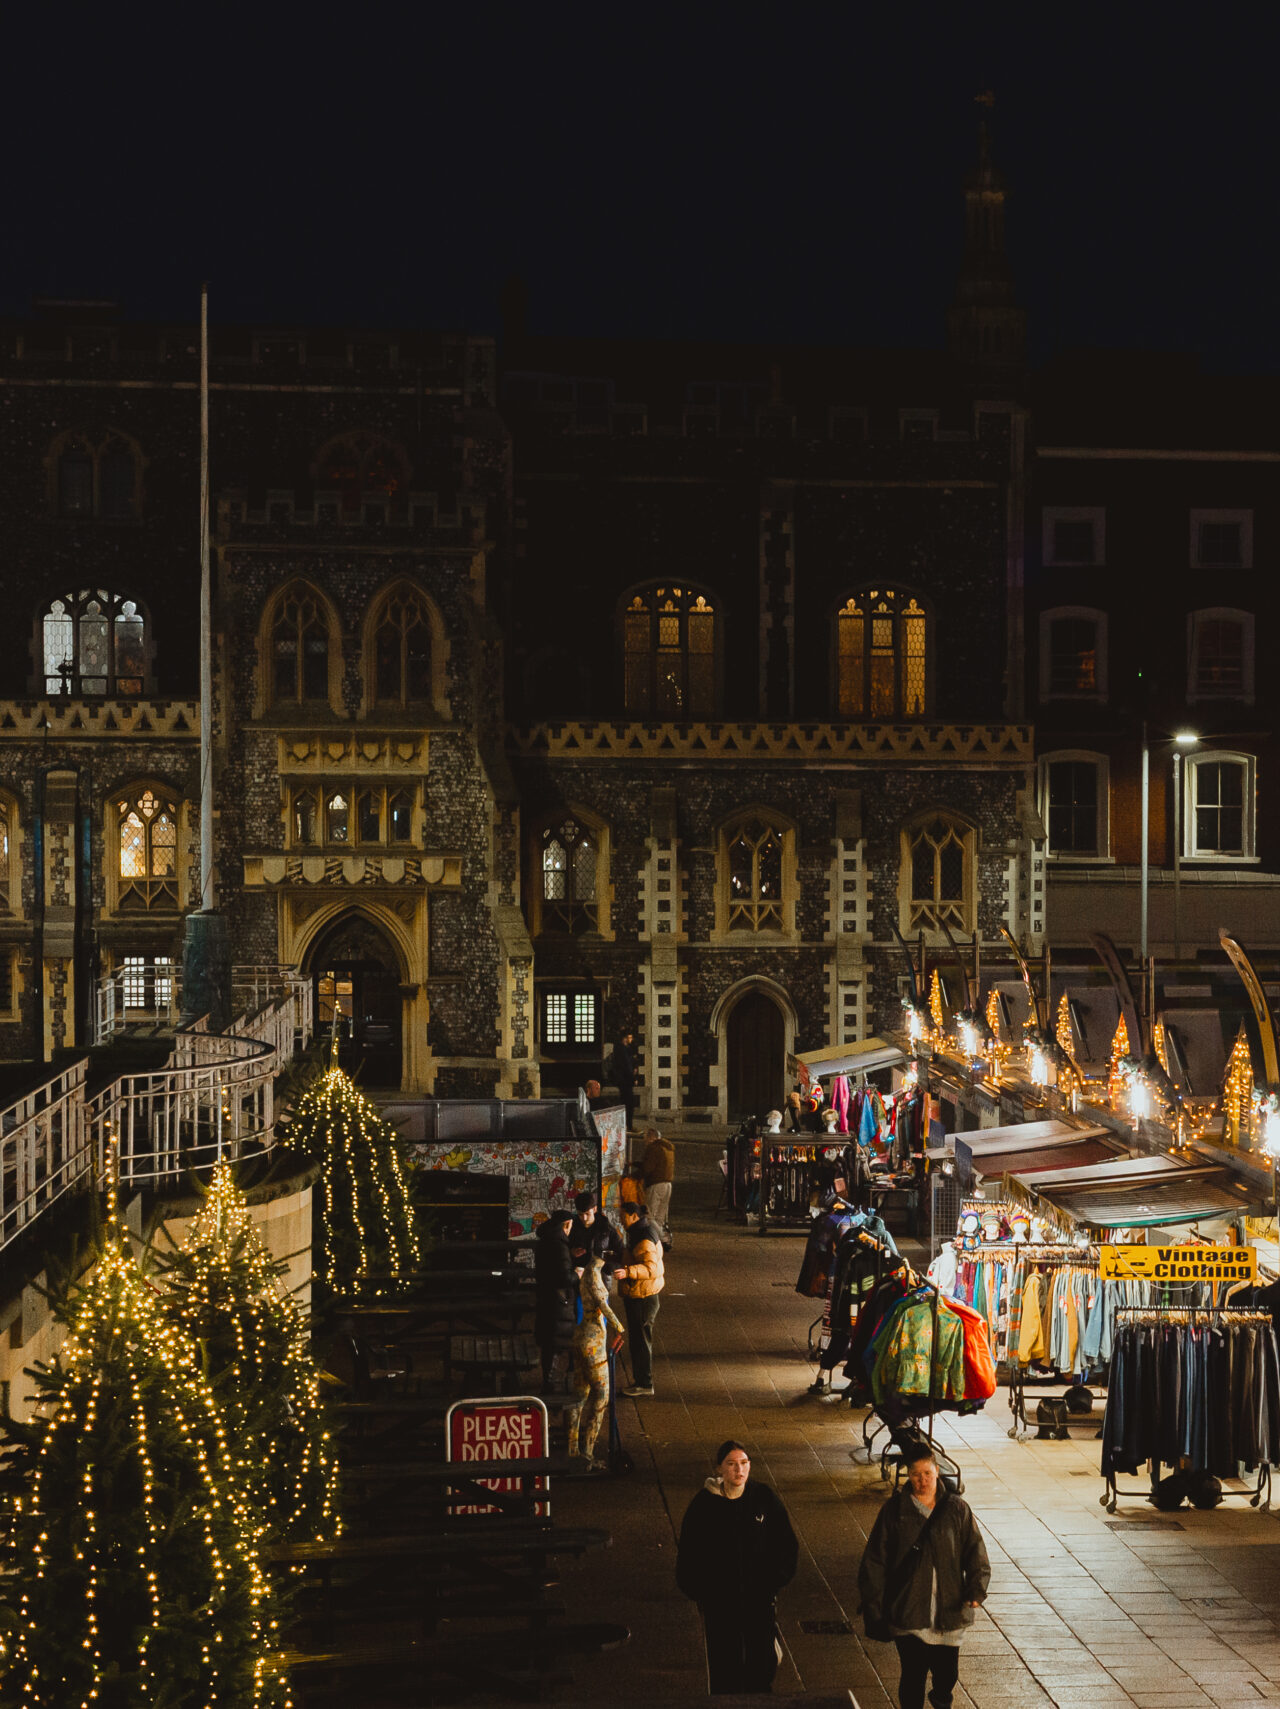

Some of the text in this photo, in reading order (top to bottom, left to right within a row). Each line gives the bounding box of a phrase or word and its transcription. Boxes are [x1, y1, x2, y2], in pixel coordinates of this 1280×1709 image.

[1157, 1249, 1249, 1263] Vintage
[1154, 1263, 1252, 1279] Clothing
[463, 1414, 533, 1441] PLEASE
[461, 1440, 533, 1462] DO NOT
